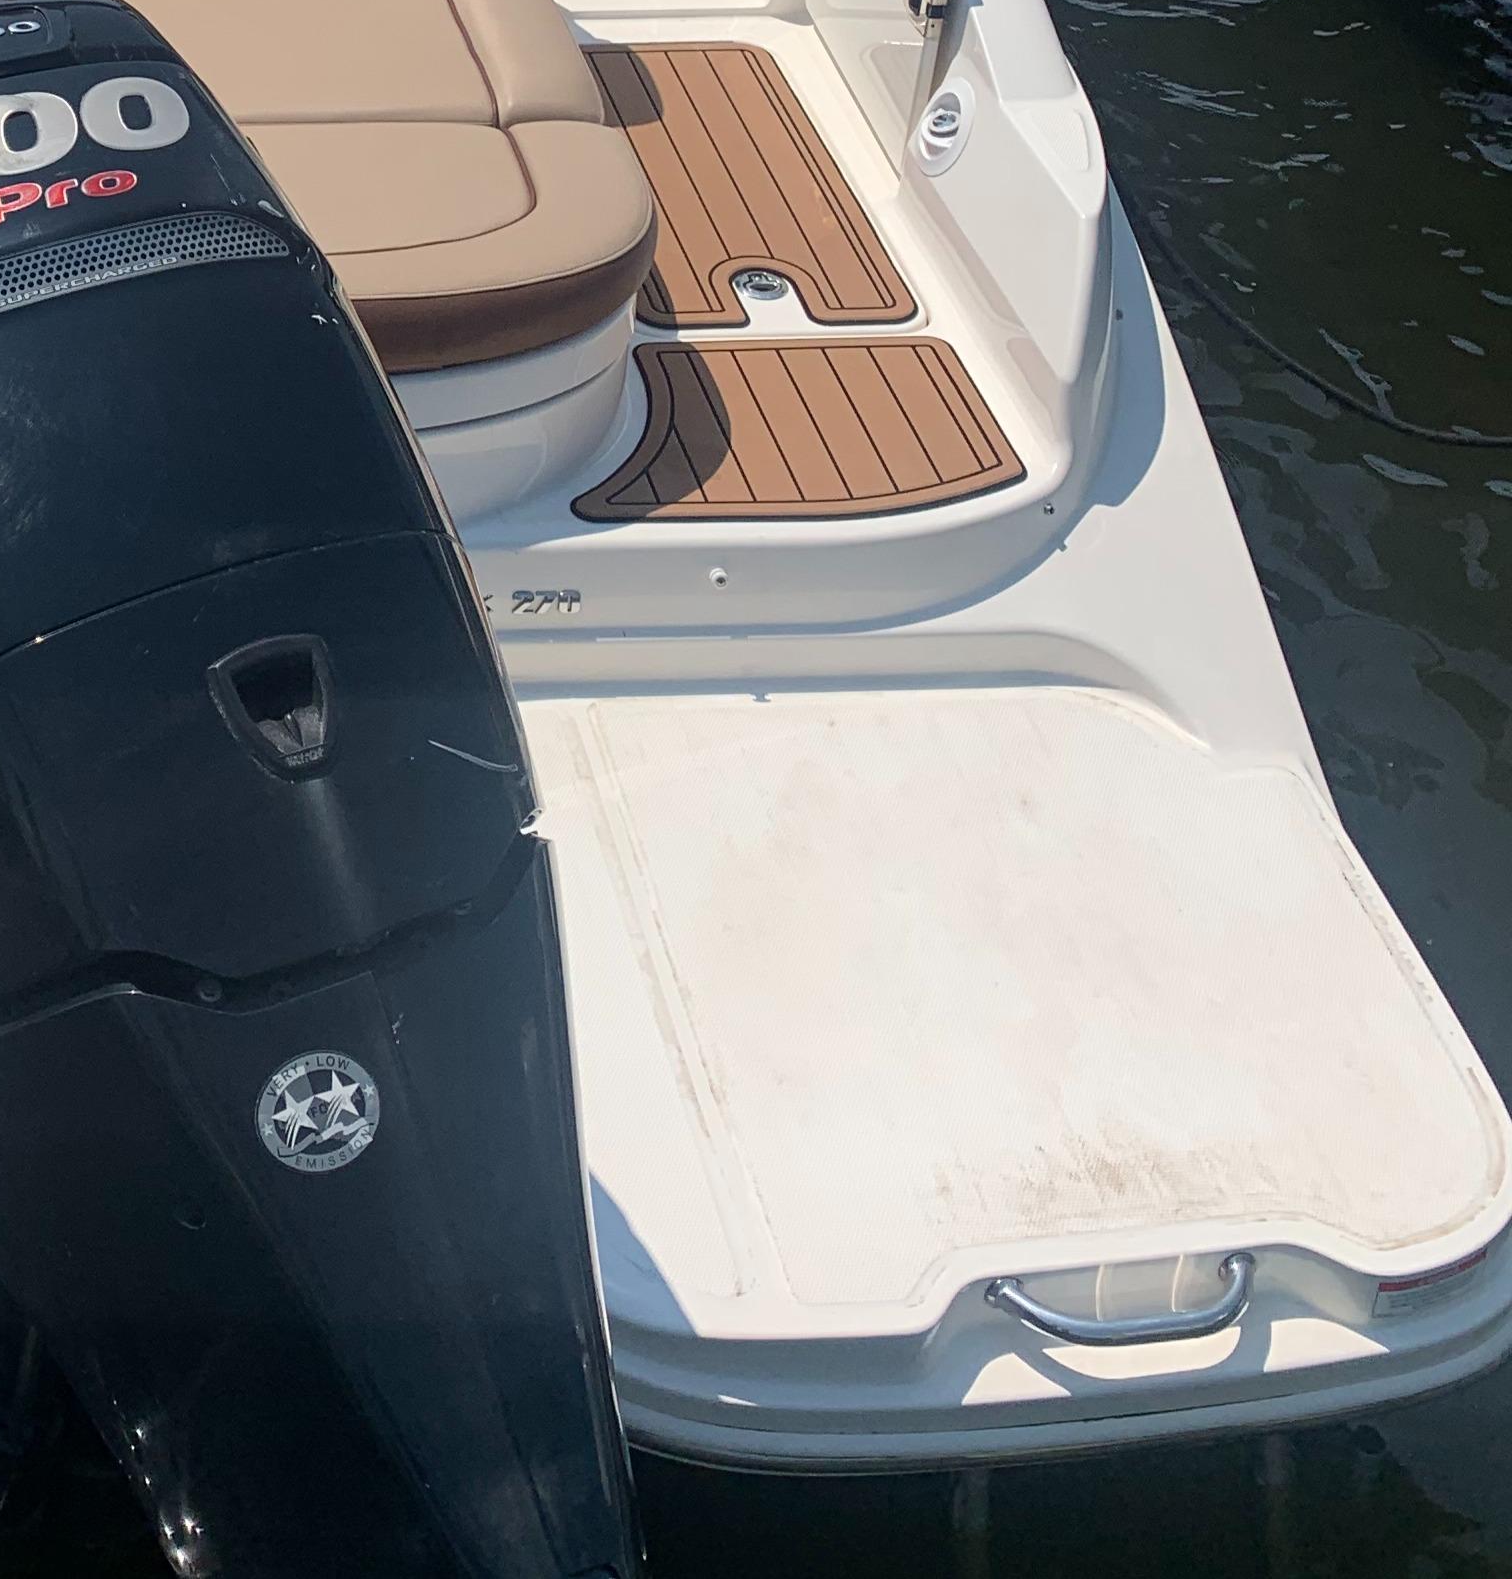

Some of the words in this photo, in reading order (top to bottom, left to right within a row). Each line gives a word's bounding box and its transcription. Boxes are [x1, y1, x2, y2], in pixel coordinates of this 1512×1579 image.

[511, 588, 582, 615] 270
[266, 1062, 299, 1098] VERY
[316, 1054, 350, 1071] LOW
[294, 1128, 373, 1168] EMISSION
